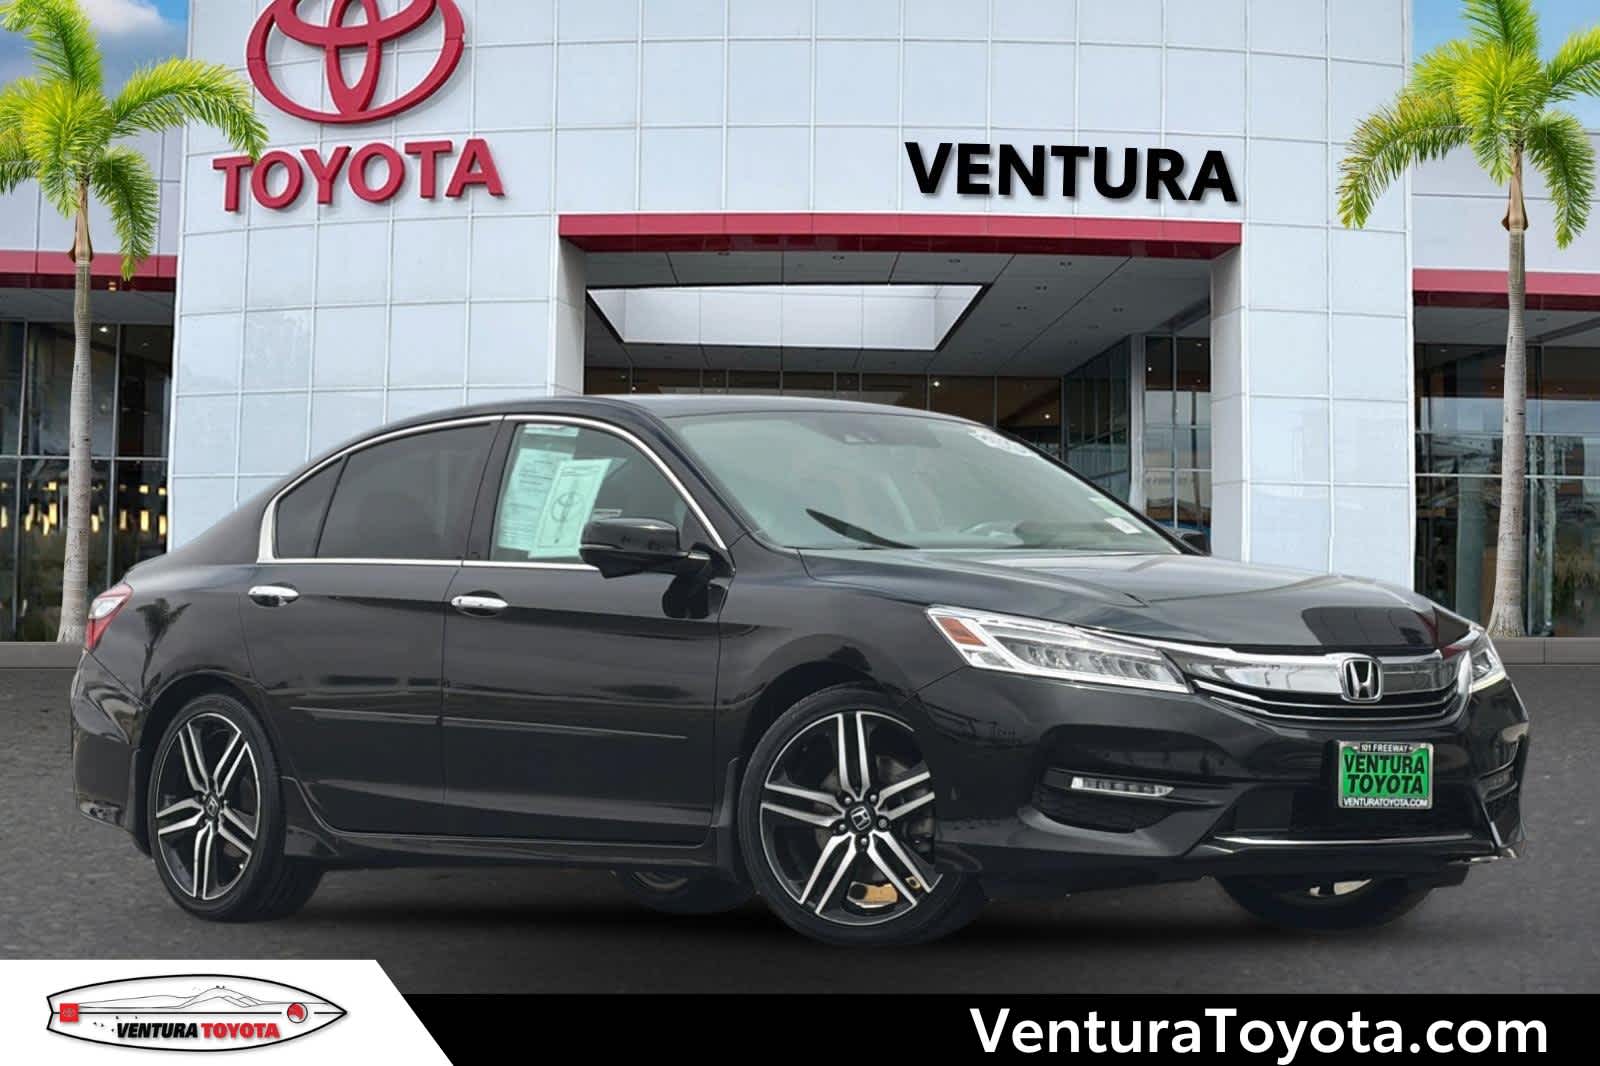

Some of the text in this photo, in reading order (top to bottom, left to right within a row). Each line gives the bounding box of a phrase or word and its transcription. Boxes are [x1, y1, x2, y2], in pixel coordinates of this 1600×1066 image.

[212, 138, 505, 212] TOYOTA
[904, 141, 1238, 203] VENTURA
[1361, 744, 1409, 753] 101 FREEWAY
[1343, 754, 1425, 774] VENTURA
[1347, 774, 1423, 794] TOYOTA
[1343, 797, 1428, 807] VENTURATOYOTA.COM
